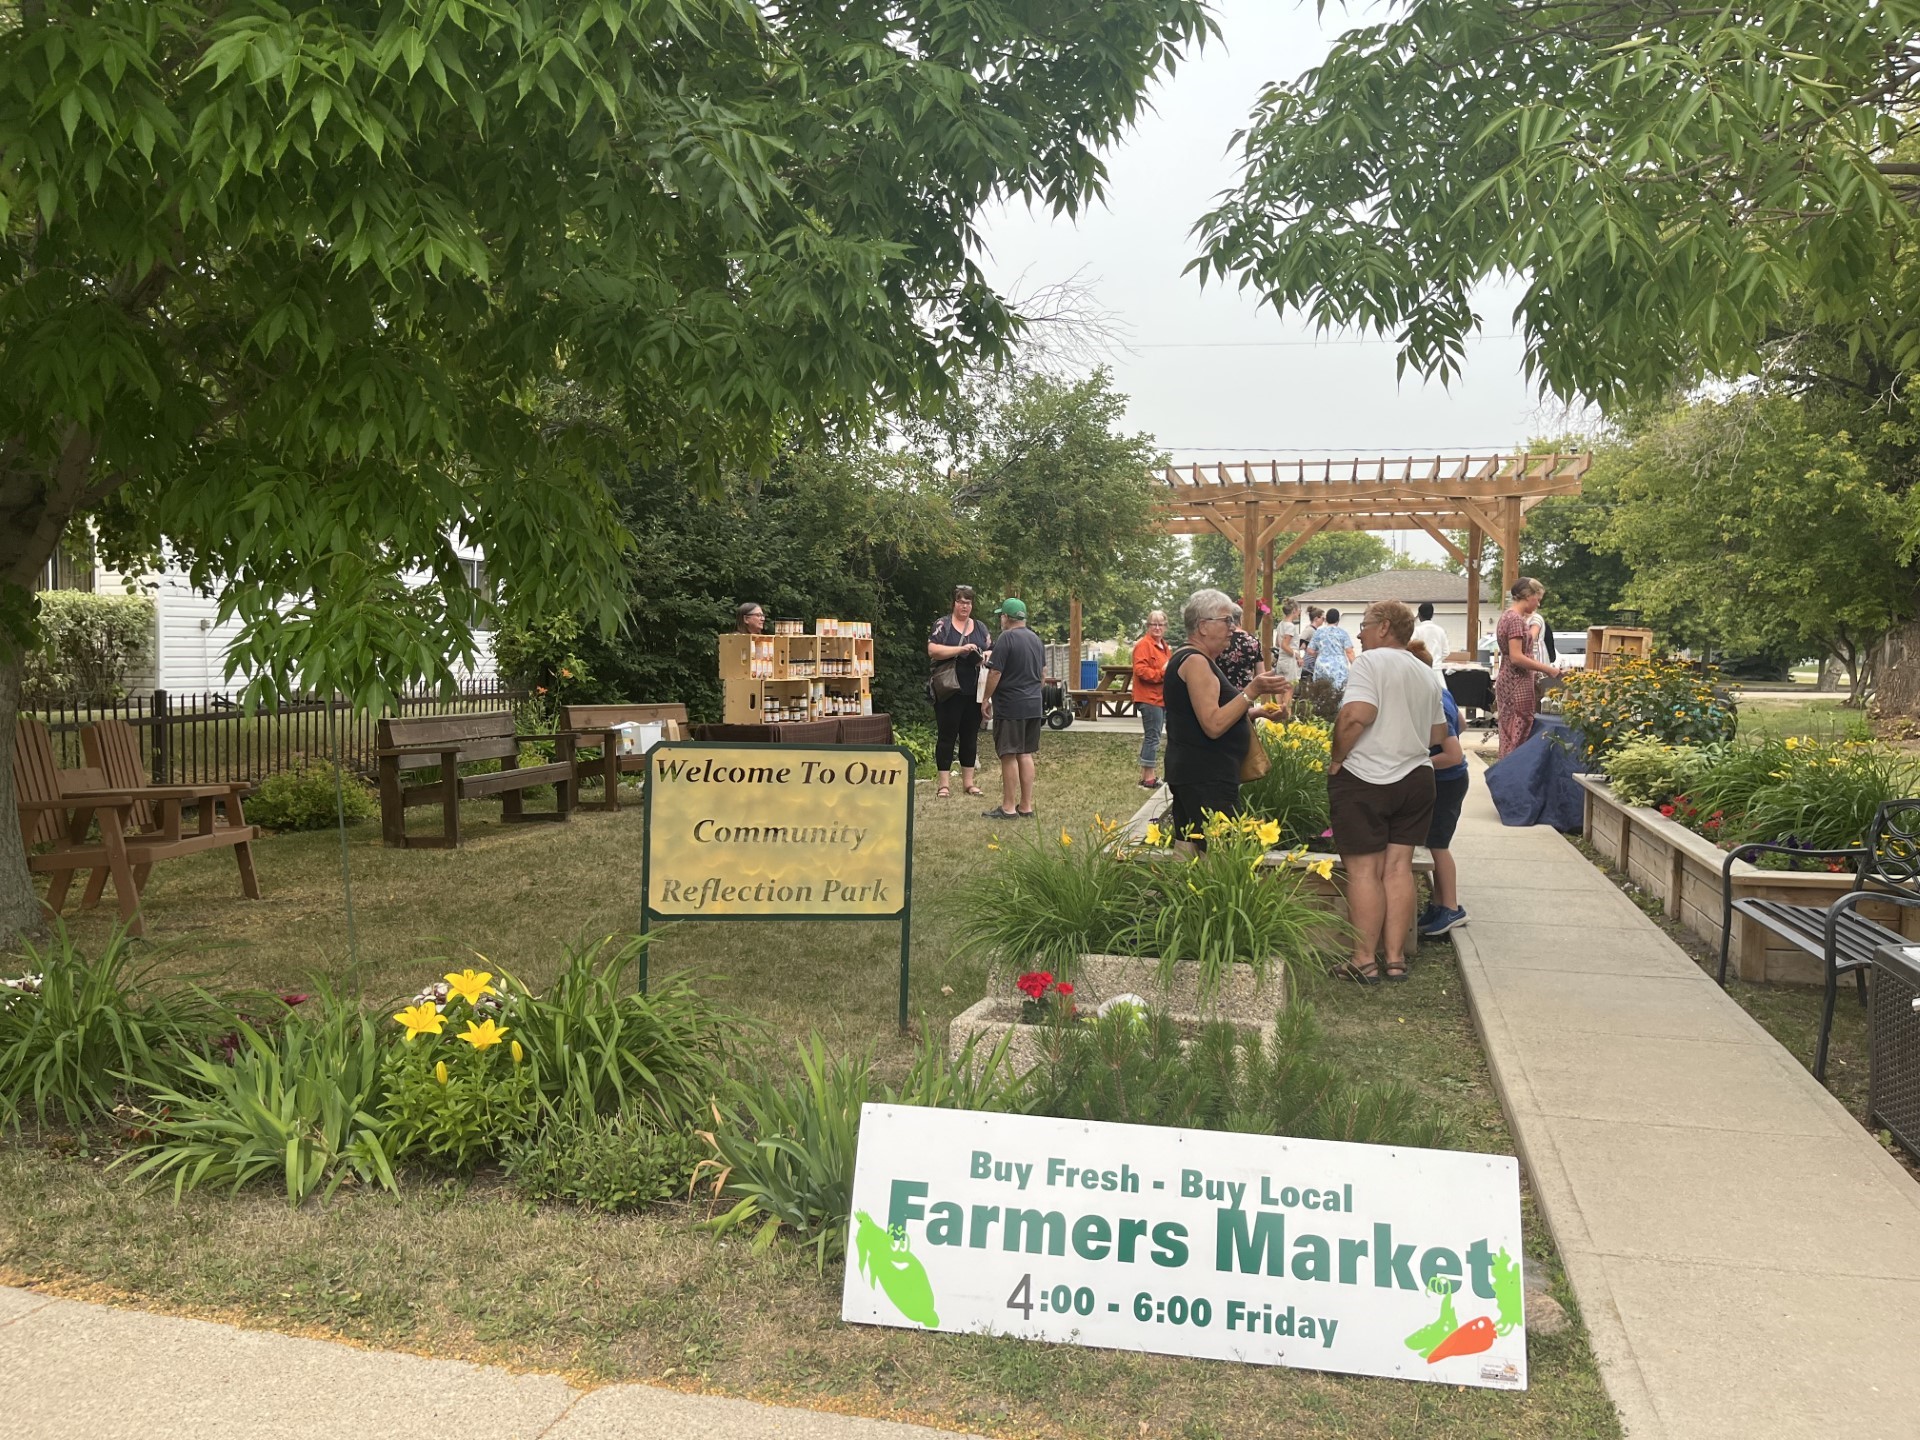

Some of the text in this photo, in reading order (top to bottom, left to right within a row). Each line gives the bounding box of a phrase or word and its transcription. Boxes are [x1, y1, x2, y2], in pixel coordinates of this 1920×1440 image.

[656, 758, 902, 786] Welcome To Our
[693, 819, 867, 851] Community
[660, 878, 889, 910] Reflection Park
[970, 1151, 1353, 1213] Buy Fresh - Buy Local
[887, 1179, 1497, 1300] Farmers Market
[1006, 1273, 1338, 1349] 4:00 - 6:00 Friday
